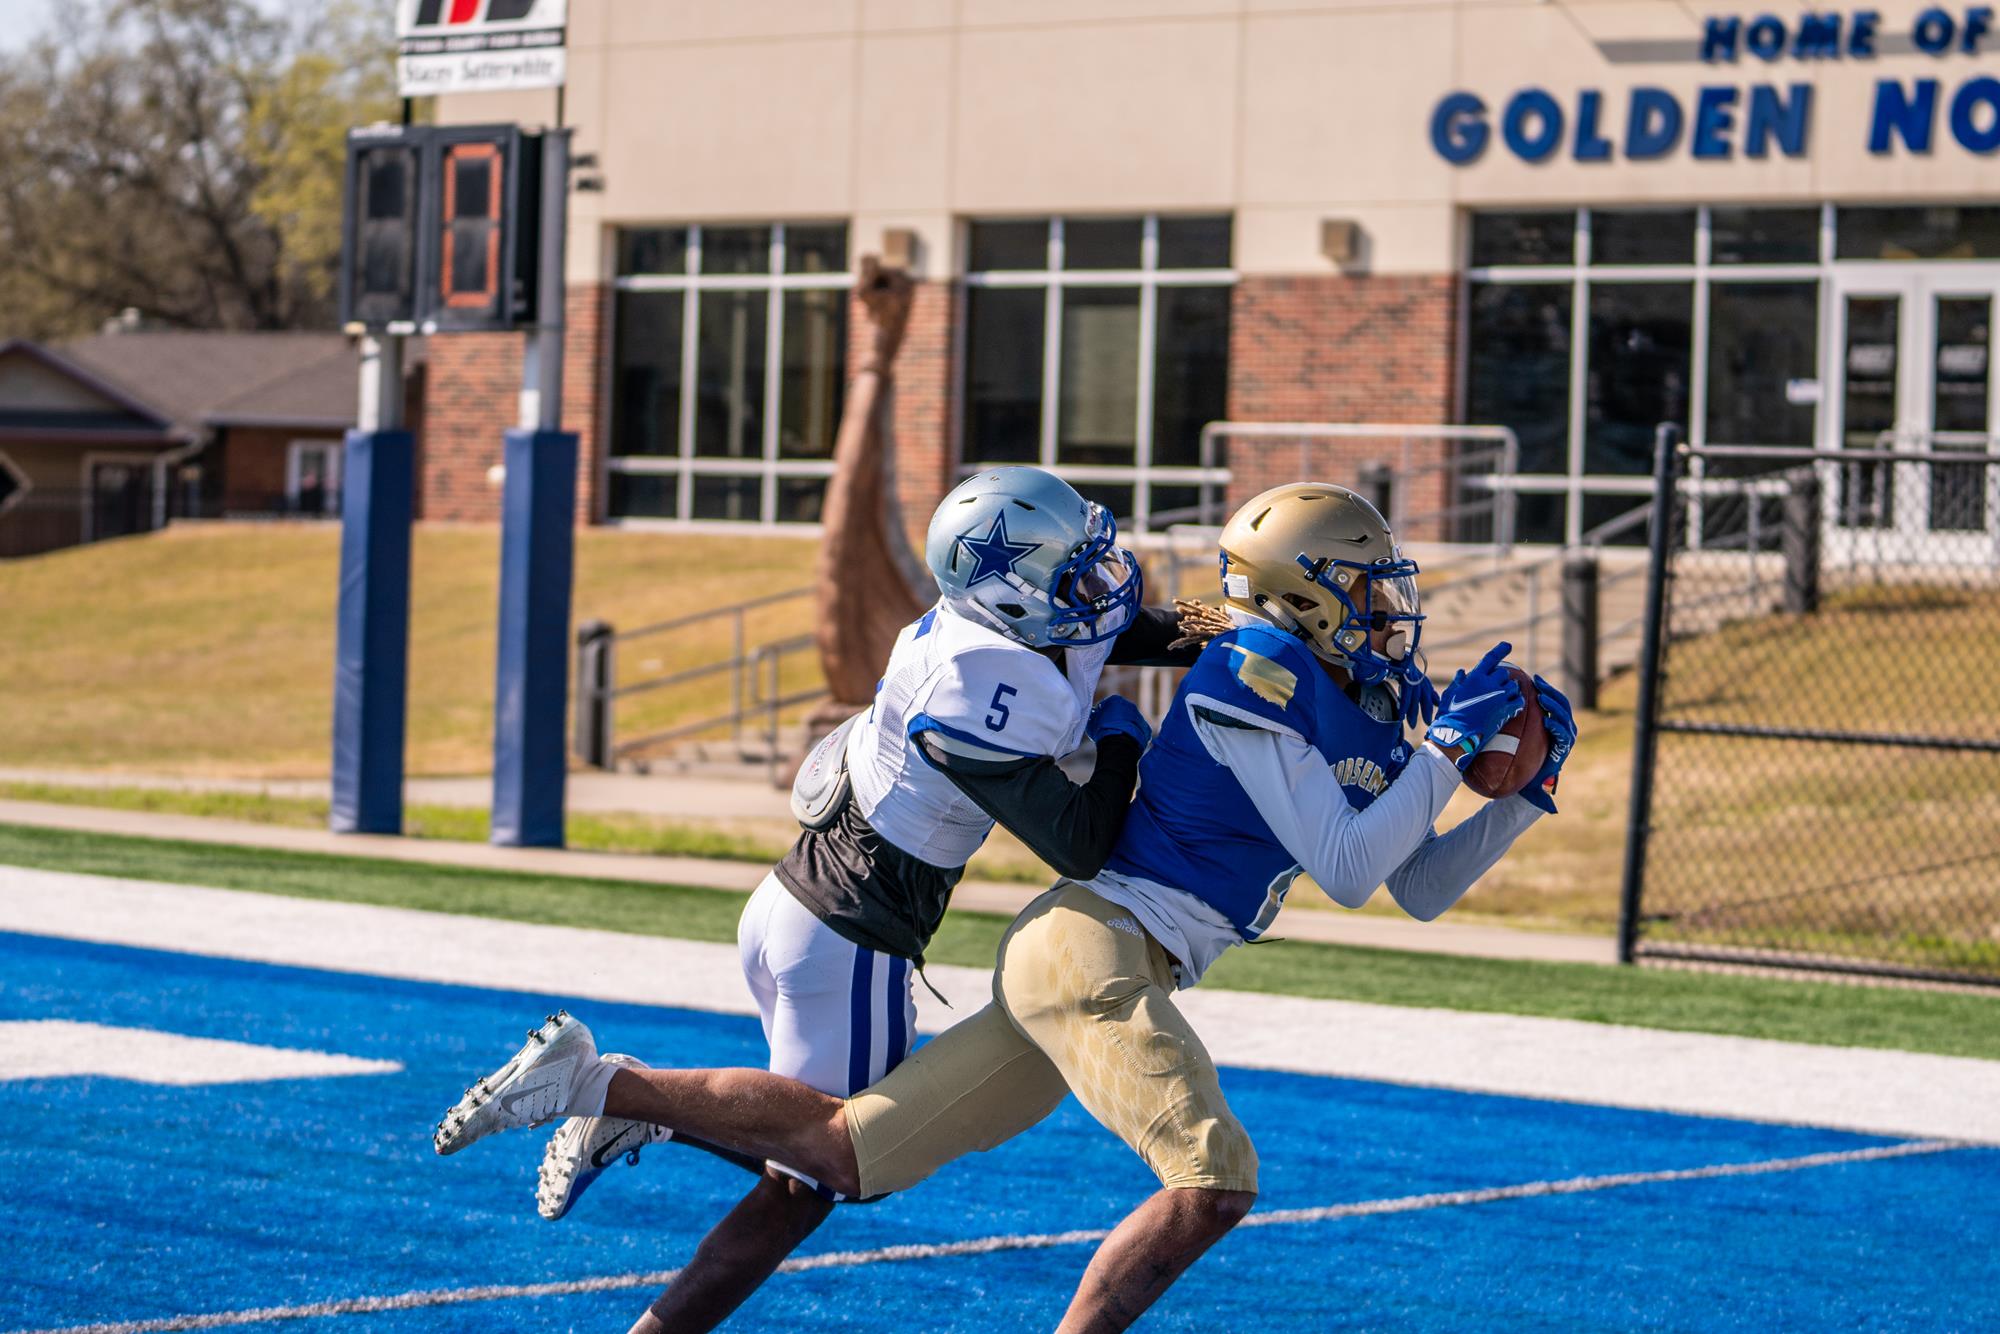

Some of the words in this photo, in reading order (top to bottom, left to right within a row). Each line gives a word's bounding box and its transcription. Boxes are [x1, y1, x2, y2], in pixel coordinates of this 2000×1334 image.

[1702, 14, 1881, 61] HOME
[1914, 8, 1994, 54] OF
[1429, 84, 1813, 164] GOLDEN
[1868, 77, 2000, 155] NO
[985, 682, 1017, 732] 5
